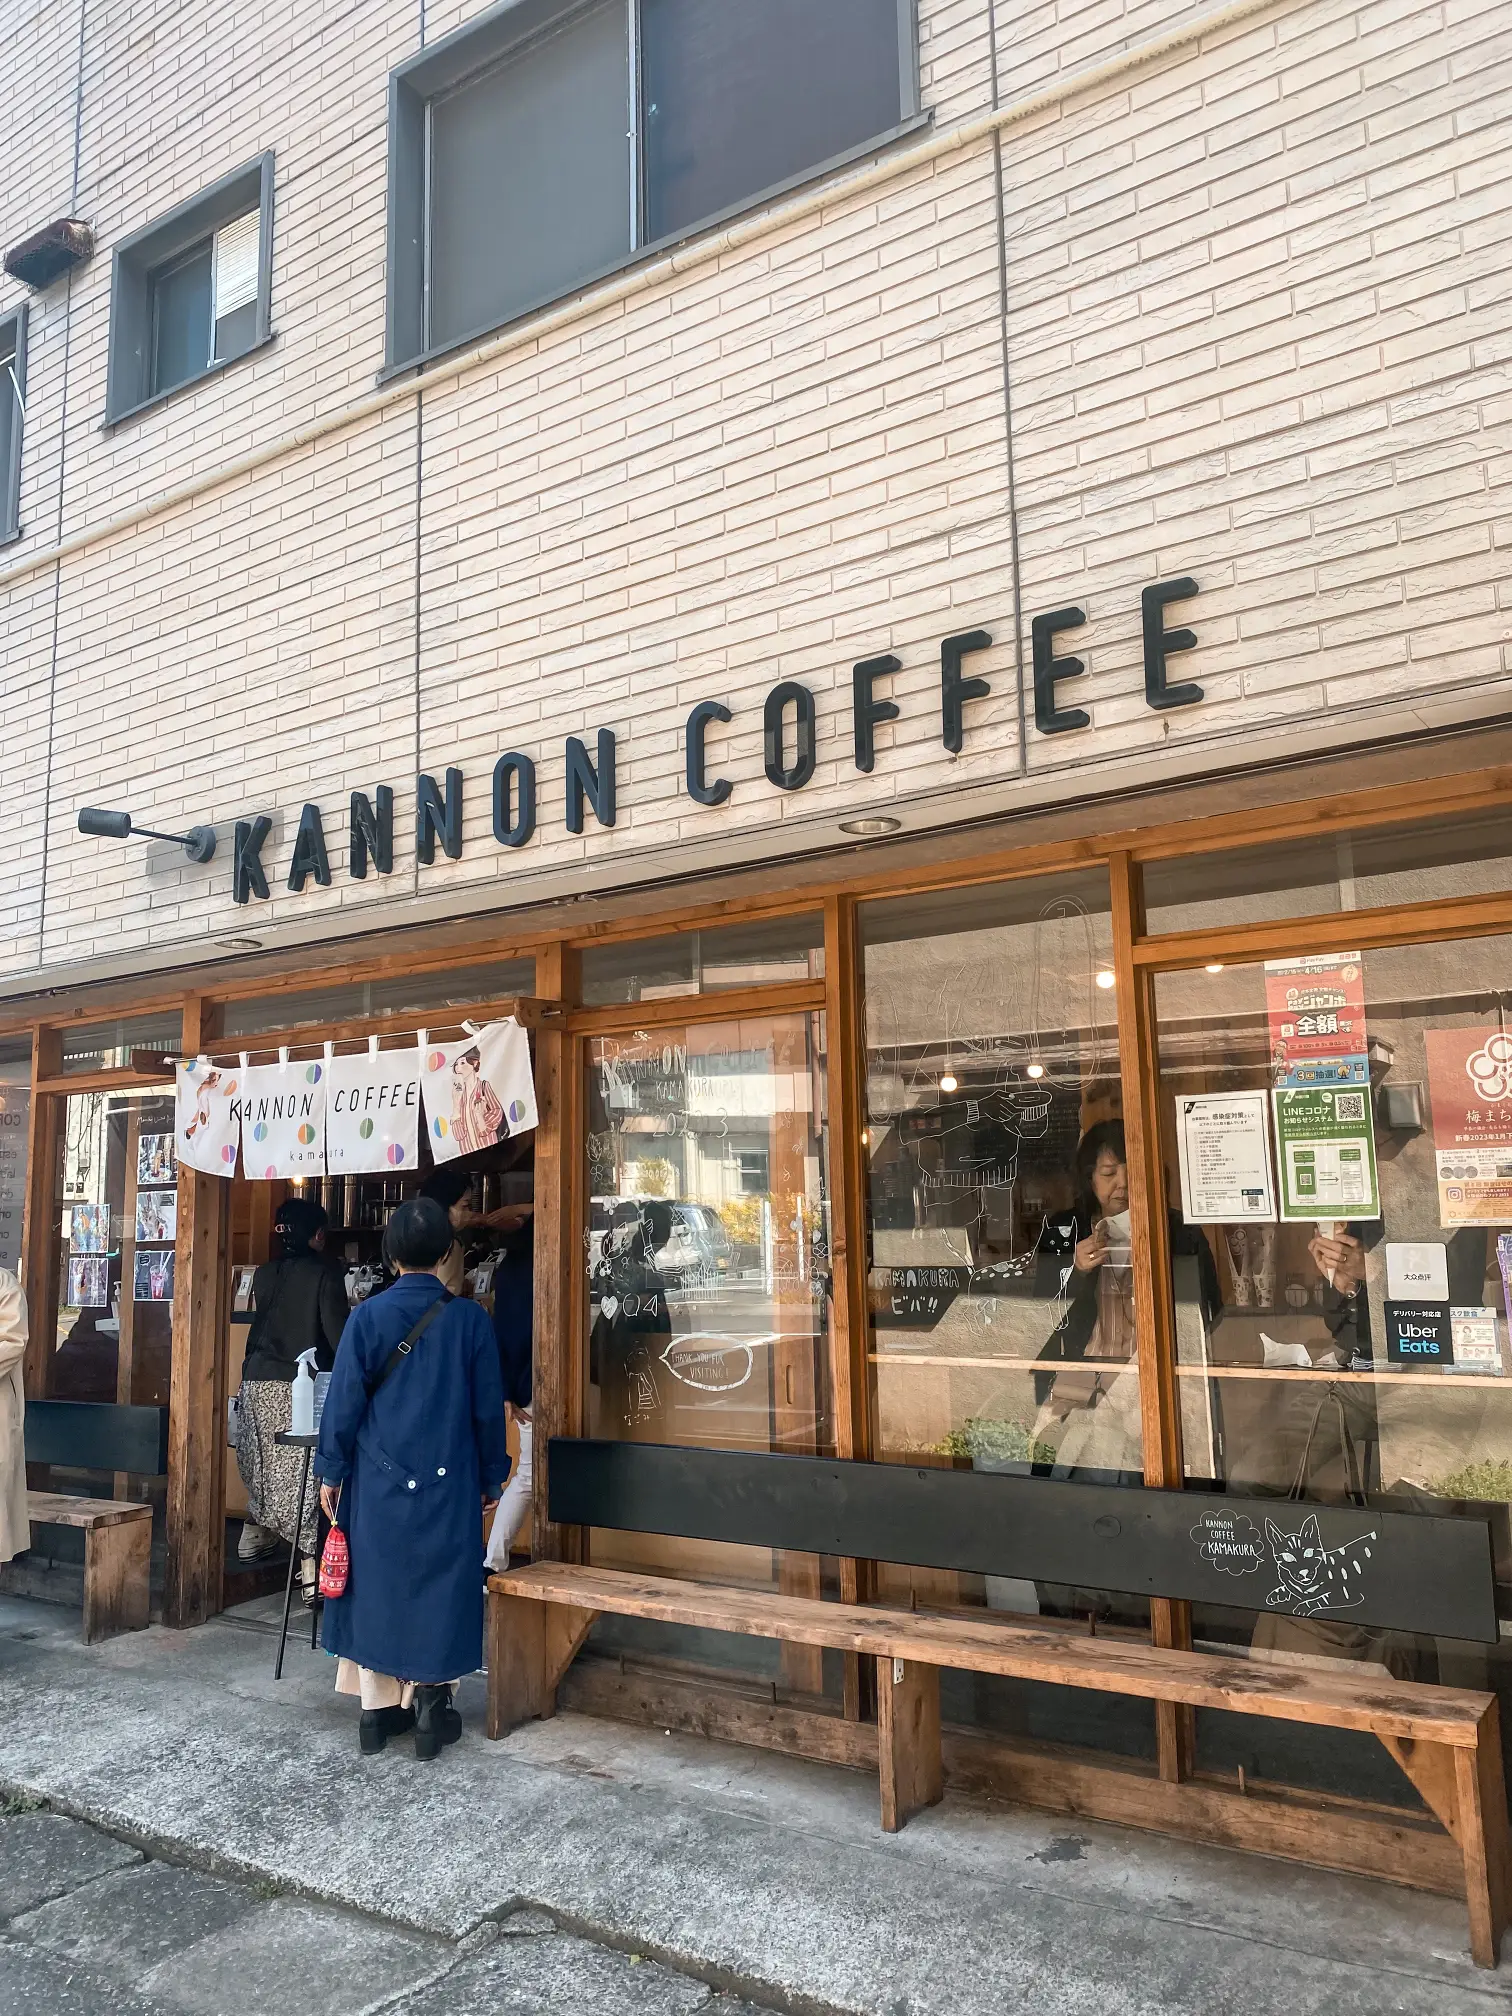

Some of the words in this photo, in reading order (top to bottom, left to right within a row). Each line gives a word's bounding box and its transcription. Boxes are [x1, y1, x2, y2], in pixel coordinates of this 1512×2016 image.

[233, 728, 616, 904] KANNON
[686, 577, 1205, 806] COFFEE
[1296, 1014, 1339, 1036] 全額
[229, 1093, 314, 1122] KANNON
[334, 1082, 416, 1113] COFFEE
[1283, 1106, 1331, 1116] LINEコロナ
[1283, 1116, 1333, 1125] お知らせシステム
[874, 1268, 960, 1288] KAMAKURA
[1404, 1273, 1431, 1281] 大众点评
[1393, 1310, 1441, 1318] デリバリー対応店
[1398, 1323, 1438, 1338] Uber
[1400, 1339, 1440, 1353] Eats
[671, 1351, 693, 1364] THANK
[697, 1352, 709, 1364] YOU
[1205, 1519, 1234, 1529] KANNON
[1210, 1530, 1236, 1541] COFFEE
[1207, 1541, 1256, 1556] KAMAKURA
